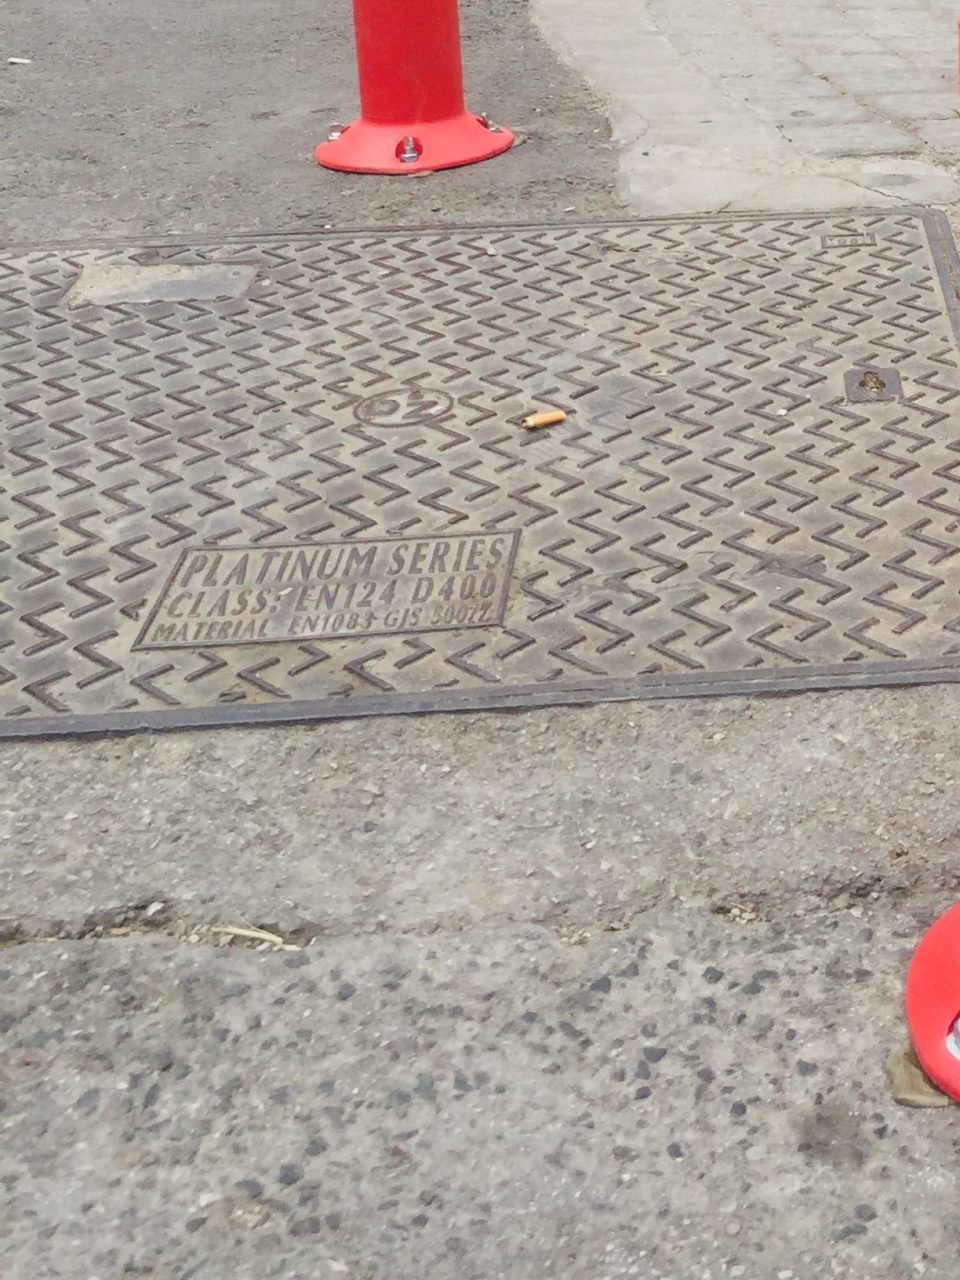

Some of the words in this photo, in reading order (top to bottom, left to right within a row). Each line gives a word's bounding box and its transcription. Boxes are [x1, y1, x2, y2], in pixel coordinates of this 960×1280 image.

[180, 545, 378, 588] PLATINUM
[387, 537, 506, 576] SERIES
[166, 586, 281, 619] CLASS:
[294, 580, 397, 613] EN124
[150, 618, 268, 643] MATERIAL
